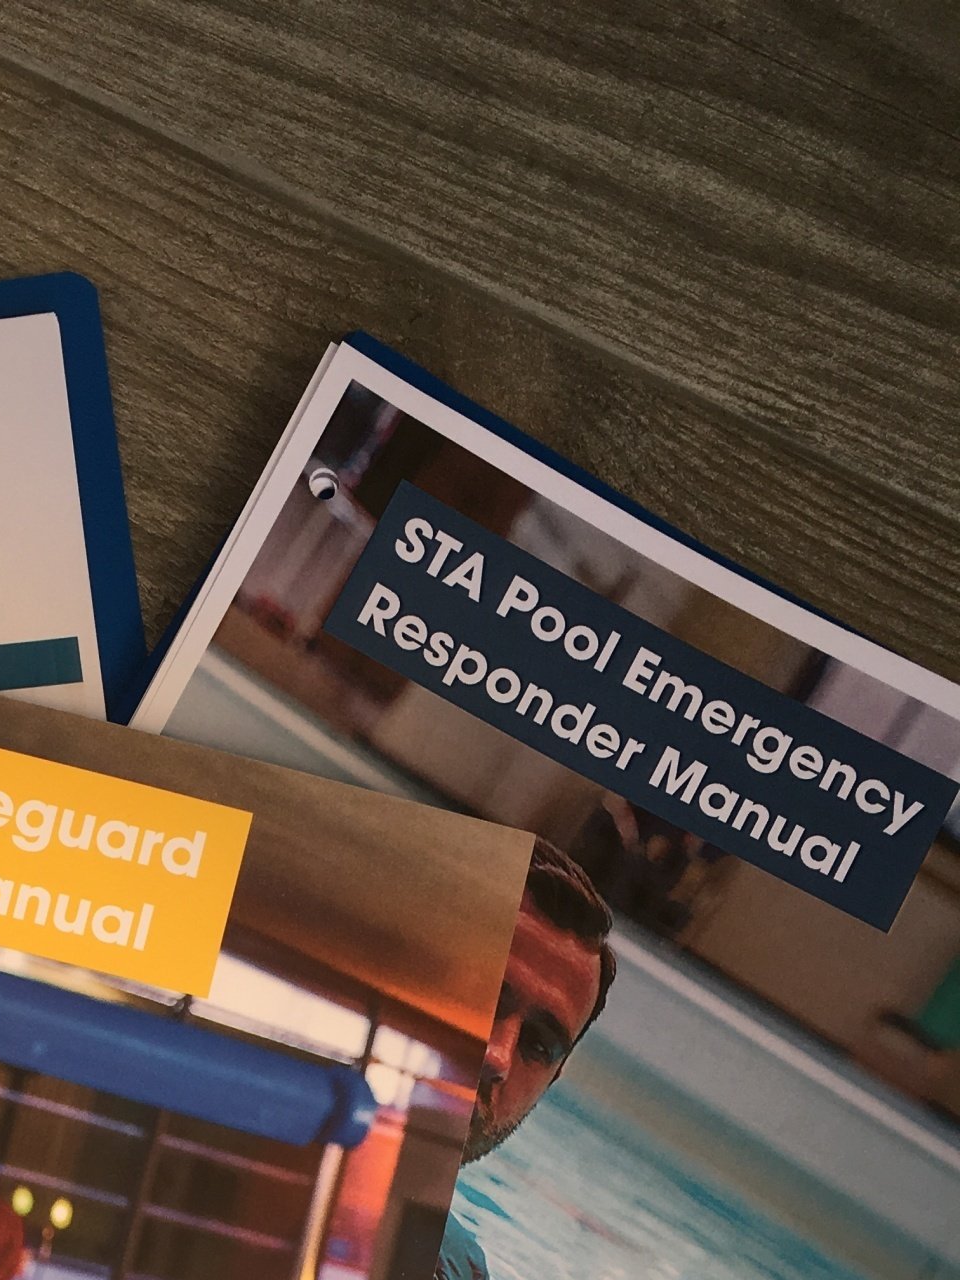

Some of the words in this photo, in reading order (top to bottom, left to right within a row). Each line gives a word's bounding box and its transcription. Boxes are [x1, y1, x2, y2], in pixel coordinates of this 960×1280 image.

[356, 582, 648, 771] Responder
[648, 746, 862, 884] Manual
[393, 516, 487, 604] STA
[496, 573, 620, 673] Pool
[623, 646, 926, 836] Emergency
